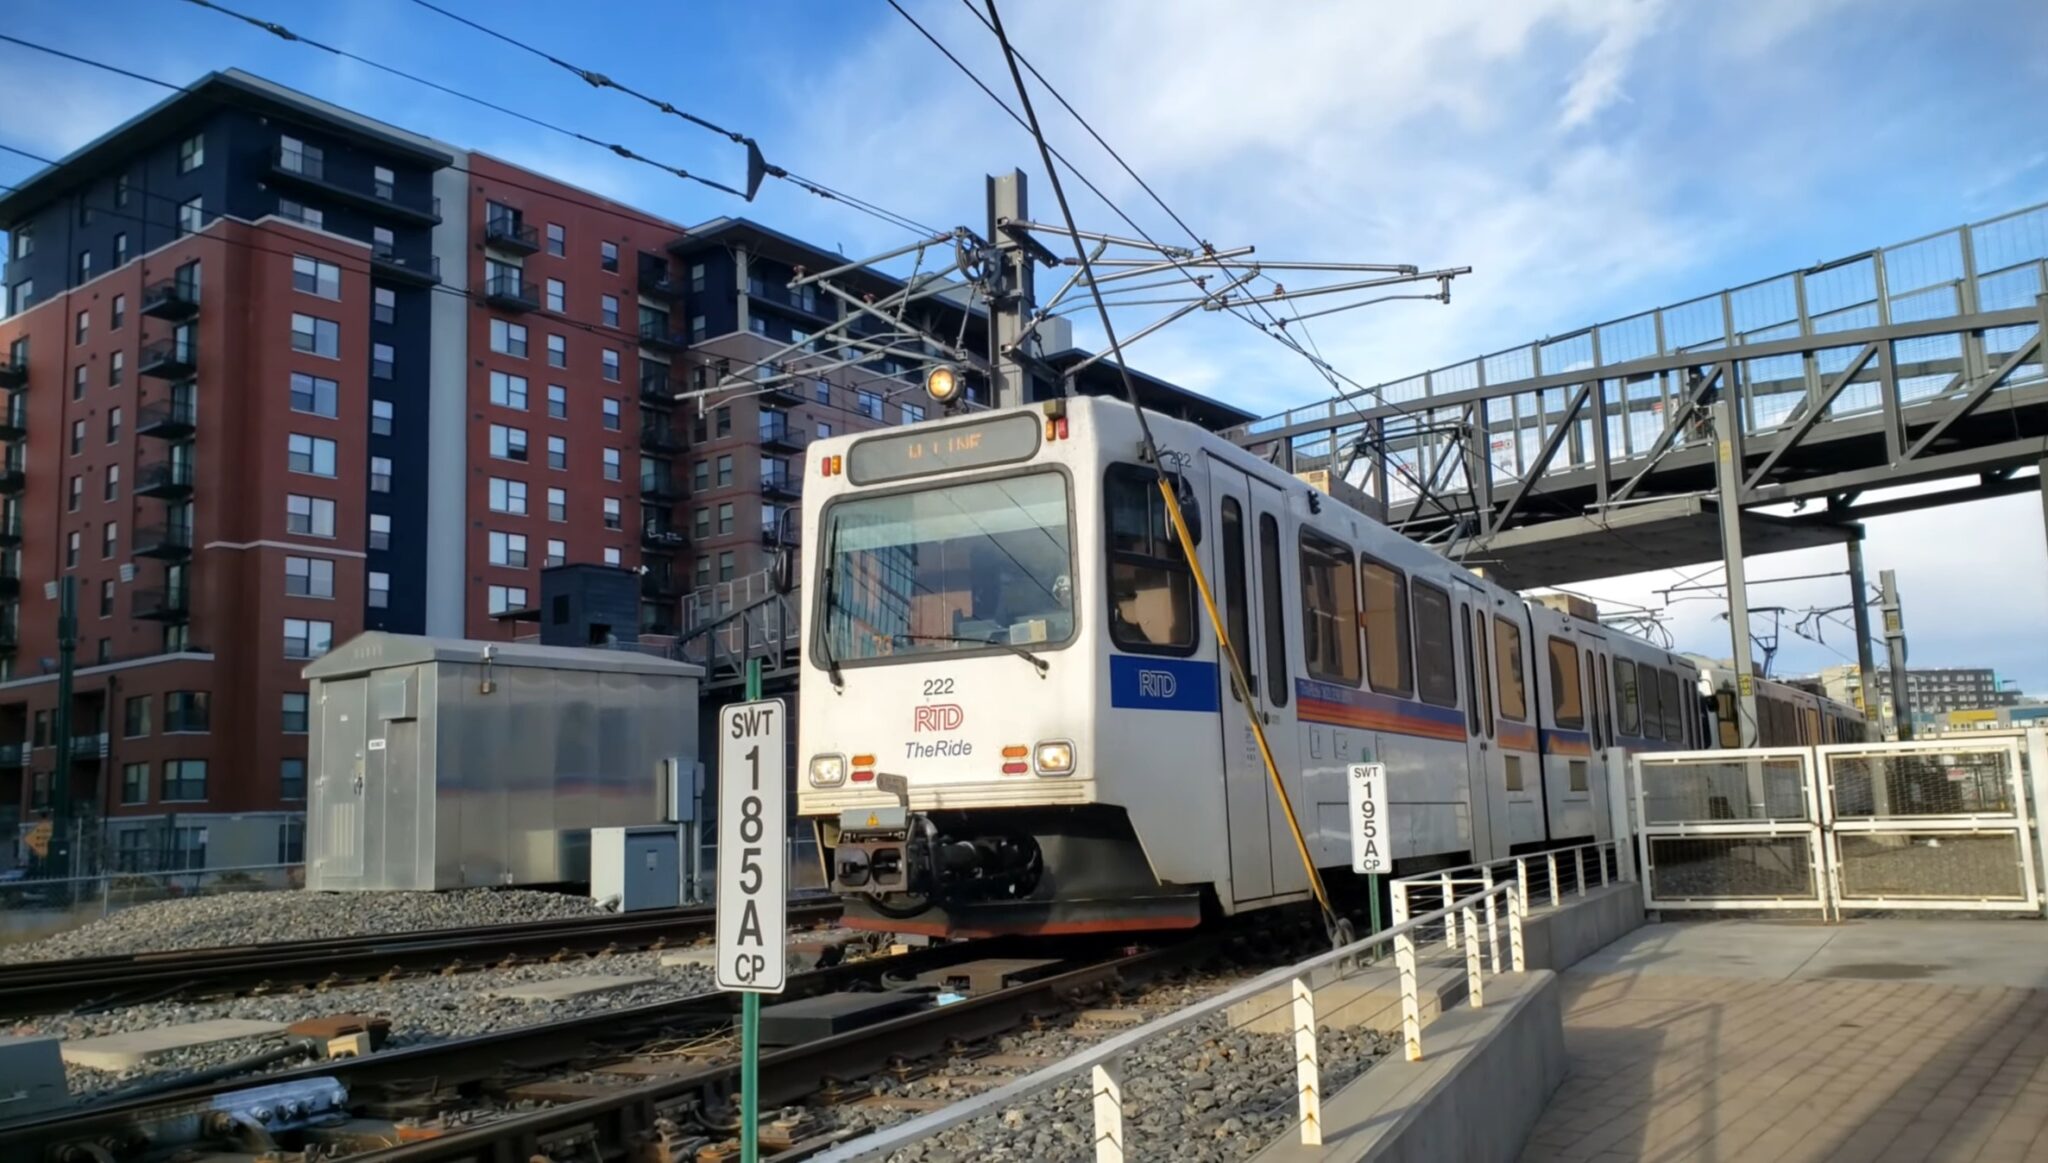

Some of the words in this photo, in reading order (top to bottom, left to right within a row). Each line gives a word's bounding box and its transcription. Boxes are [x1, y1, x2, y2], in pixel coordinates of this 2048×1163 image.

[923, 677, 955, 696] 222
[1139, 669, 1177, 698] RTD
[731, 709, 773, 740] SWT
[914, 703, 964, 733] RTD
[905, 739, 973, 759] TheRide
[1354, 766, 1379, 778] SWT
[1363, 859, 1381, 871] CP
[735, 953, 765, 983] CP
